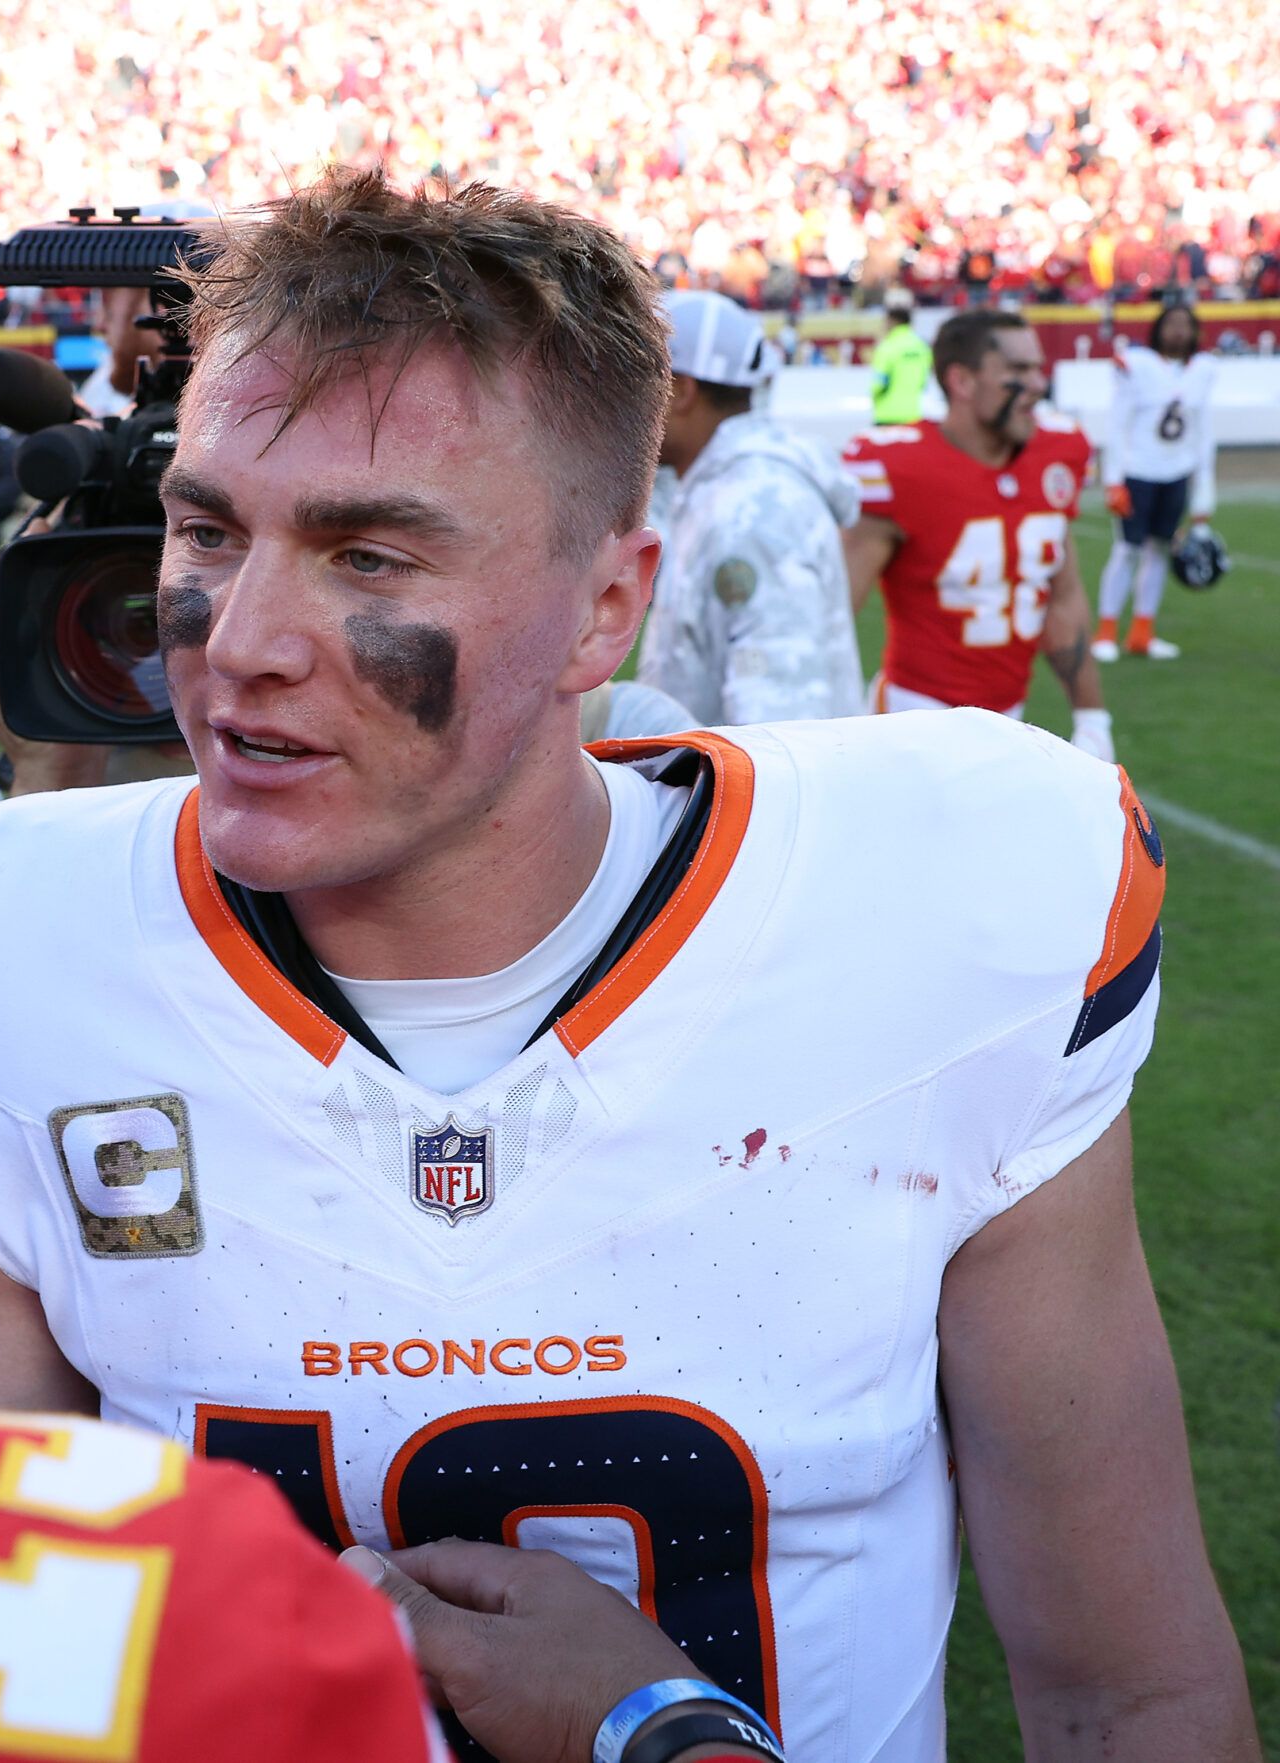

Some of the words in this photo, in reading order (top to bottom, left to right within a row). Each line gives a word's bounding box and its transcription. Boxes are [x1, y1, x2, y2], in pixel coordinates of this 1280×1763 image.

[1158, 397, 1185, 442] 6
[936, 513, 1068, 646] 48
[62, 1107, 183, 1218] C
[423, 1166, 481, 1206] NFL
[301, 1335, 627, 1377] BRONCOS
